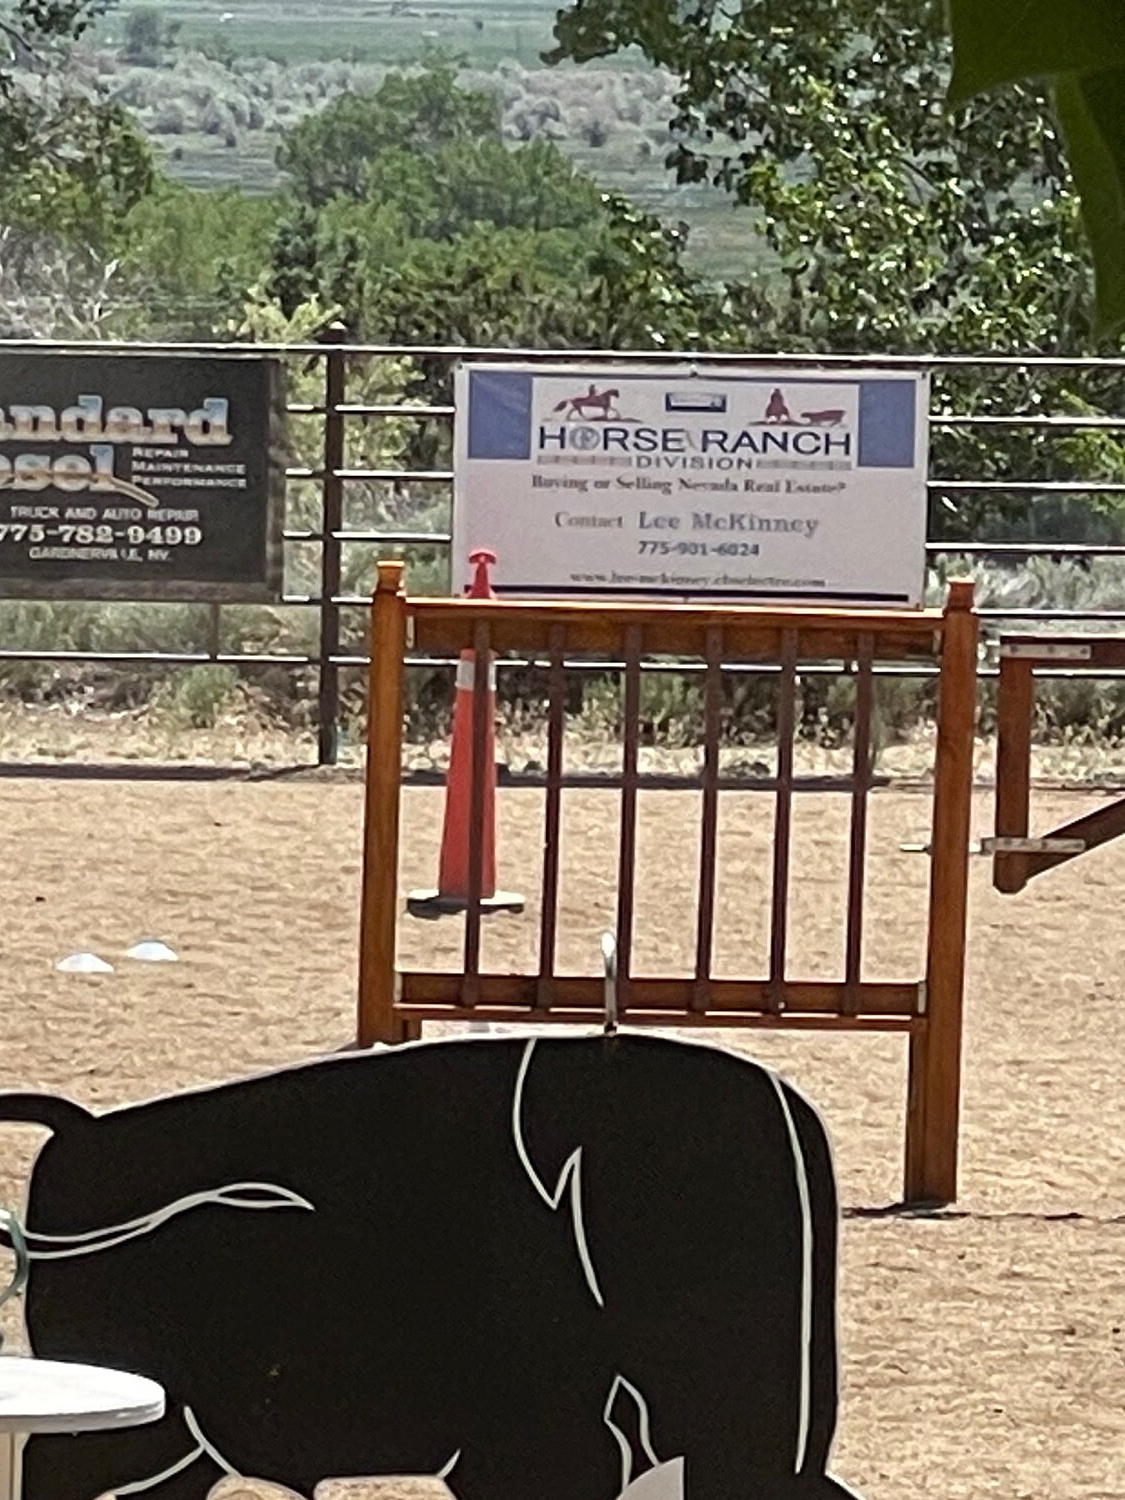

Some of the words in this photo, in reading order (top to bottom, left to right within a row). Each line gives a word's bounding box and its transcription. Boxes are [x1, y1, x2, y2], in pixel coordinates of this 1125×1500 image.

[539, 425, 686, 453] HORSE
[701, 429, 851, 456] RANCH
[132, 446, 190, 459] REPAIR
[131, 460, 247, 475] MAINTENANCE
[636, 455, 753, 471] DIVISION
[131, 475, 248, 489] PERFORMANCE
[743, 478, 781, 493] Real
[10, 505, 60, 519] TRUCK
[65, 507, 97, 520] AND
[102, 508, 143, 521] AUTO
[147, 509, 200, 522] REPAIR
[554, 510, 624, 529] Contact
[638, 510, 681, 531] Lee
[691, 511, 820, 538] McKinney
